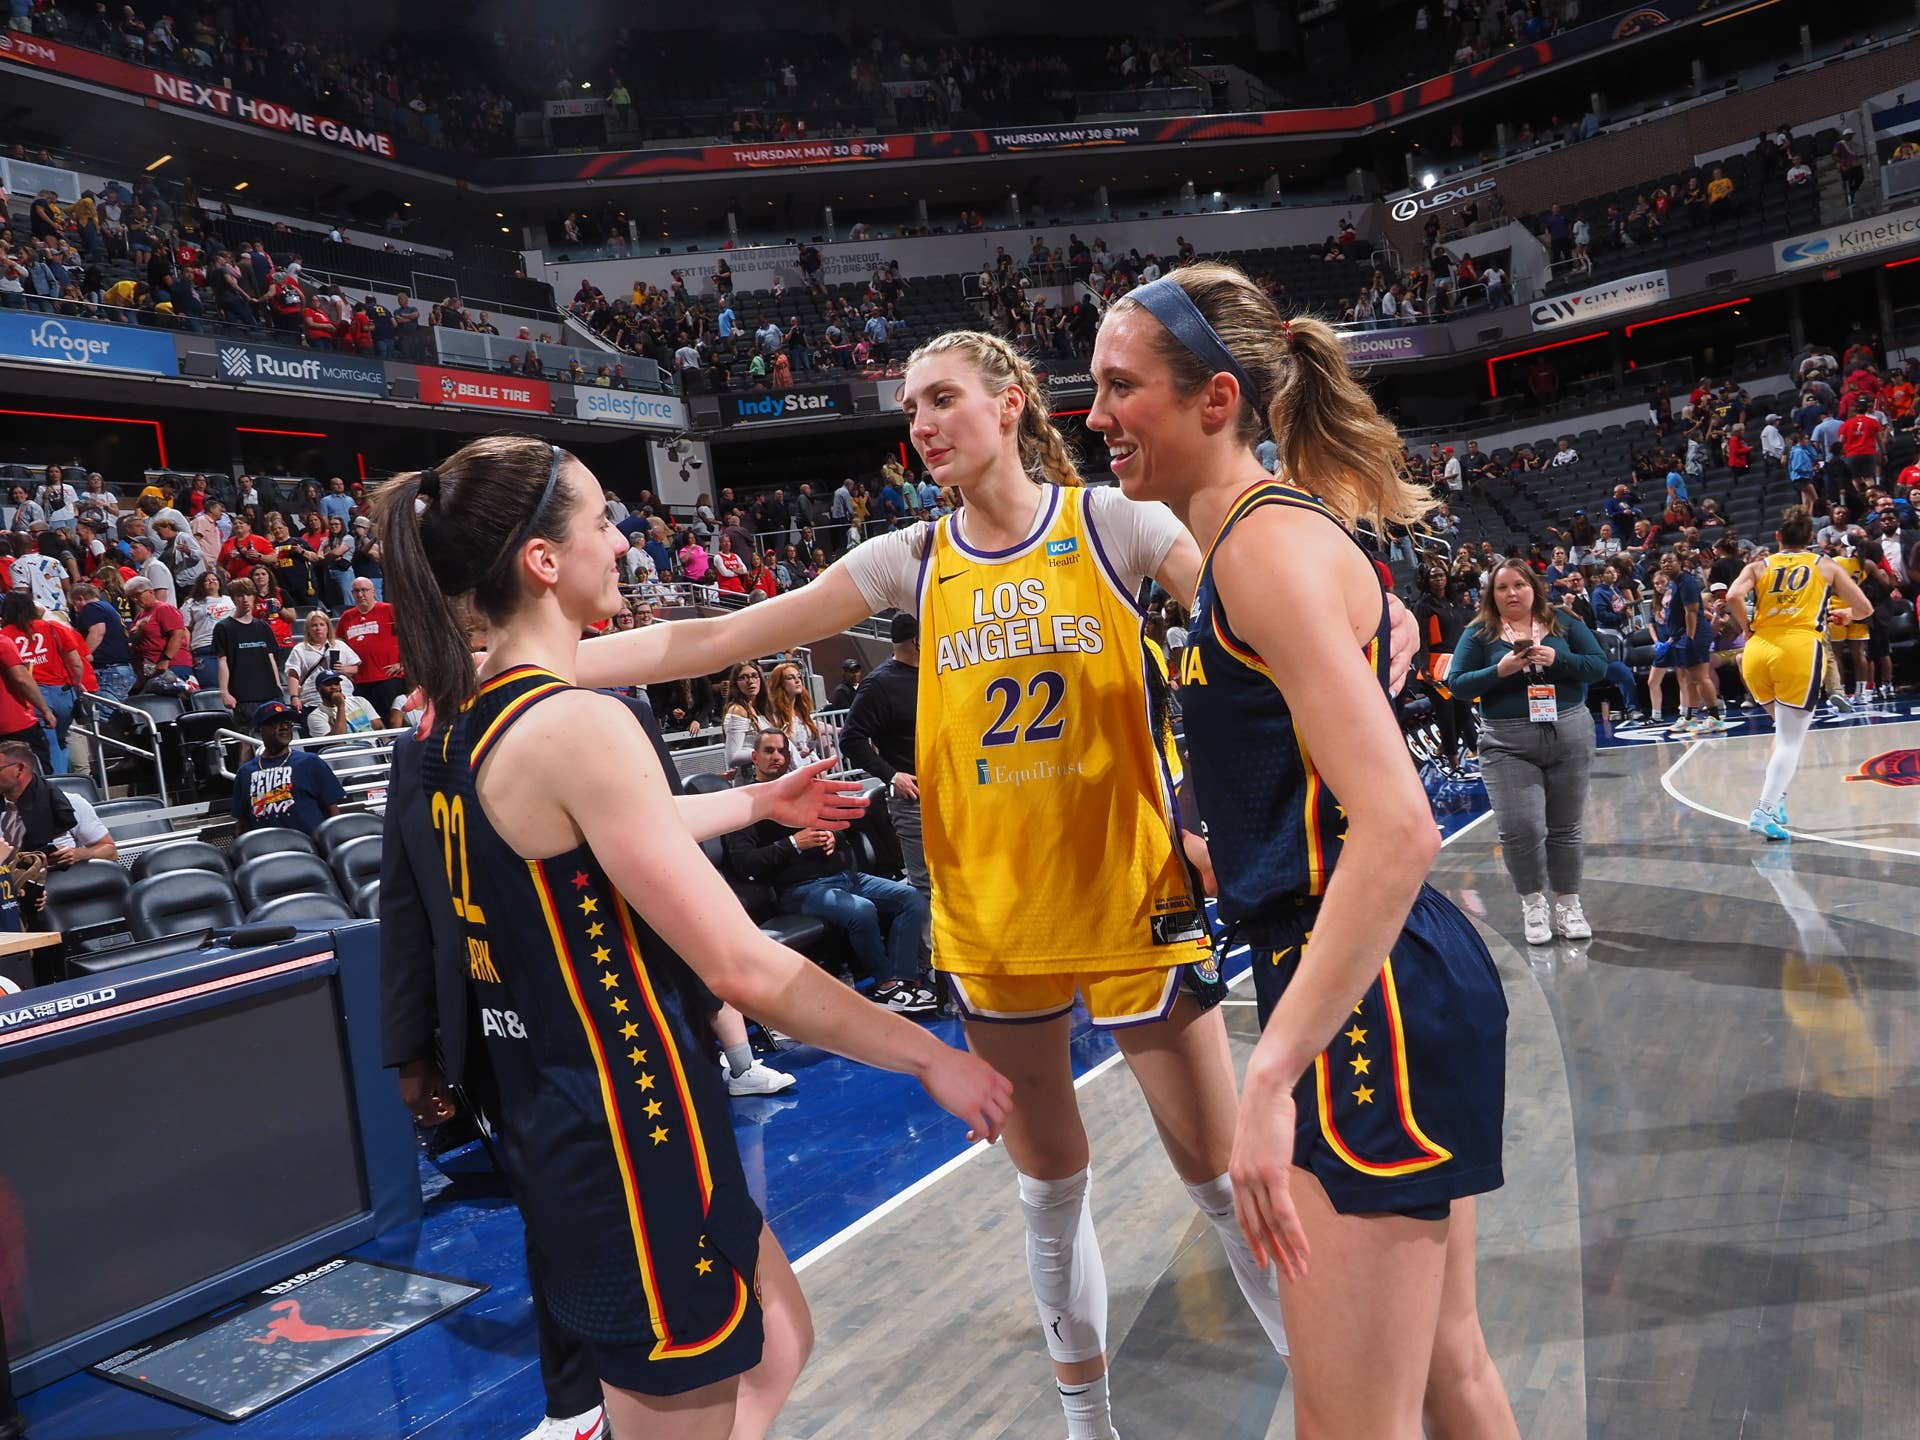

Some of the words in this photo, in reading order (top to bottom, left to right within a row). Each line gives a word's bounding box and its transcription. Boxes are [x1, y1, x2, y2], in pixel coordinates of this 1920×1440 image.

[15, 39, 56, 62] 7PM
[153, 73, 232, 112] NEXT
[236, 95, 318, 136] HOME
[319, 120, 393, 156] GAME
[994, 132, 1059, 145] THURSDAY,
[1060, 130, 1086, 141] MAY
[1087, 129, 1101, 140] 30
[1102, 128, 1115, 139] @
[1115, 127, 1139, 137] 7PM
[733, 148, 803, 162] THURSDAY,
[804, 146, 832, 158] MAY
[833, 145, 849, 156] 30
[850, 144, 863, 156] @
[863, 143, 889, 155] 7PM
[1419, 177, 1497, 209] LEXUS
[757, 248, 799, 259] ASSISTA
[824, 253, 882, 265] 07-TIMEOUT.
[729, 262, 747, 273] SUE
[1584, 289, 1618, 305] CITY
[1625, 278, 1665, 293] WIDE
[31, 320, 110, 363] Kroger
[1360, 337, 1412, 353] DONUTS
[255, 353, 321, 380] Ruoff
[322, 367, 383, 384] MORTGAGE
[1048, 372, 1092, 385] Fanatics
[458, 383, 499, 399] BELLE
[501, 388, 530, 403] TIRE
[737, 394, 835, 417] IndyStar.
[588, 393, 672, 422] salesforce
[1050, 541, 1073, 553] UCLA
[1048, 553, 1079, 568] Health
[1768, 564, 1810, 593] 10
[117, 596, 131, 610] 22
[973, 577, 1047, 625] LOS
[15, 632, 48, 658] 22
[937, 615, 1104, 676] ANGELES
[33, 653, 49, 666] ARK
[980, 669, 1067, 748] 22
[250, 766, 293, 803] FEVER
[994, 760, 1083, 787] EquiTrust
[431, 791, 486, 923] 22
[466, 936, 502, 984] ARK
[33, 1002, 56, 1013] FOR
[34, 1008, 57, 1018] THE
[56, 988, 116, 1013] BOLD
[260, 1259, 348, 1295] Wilson
